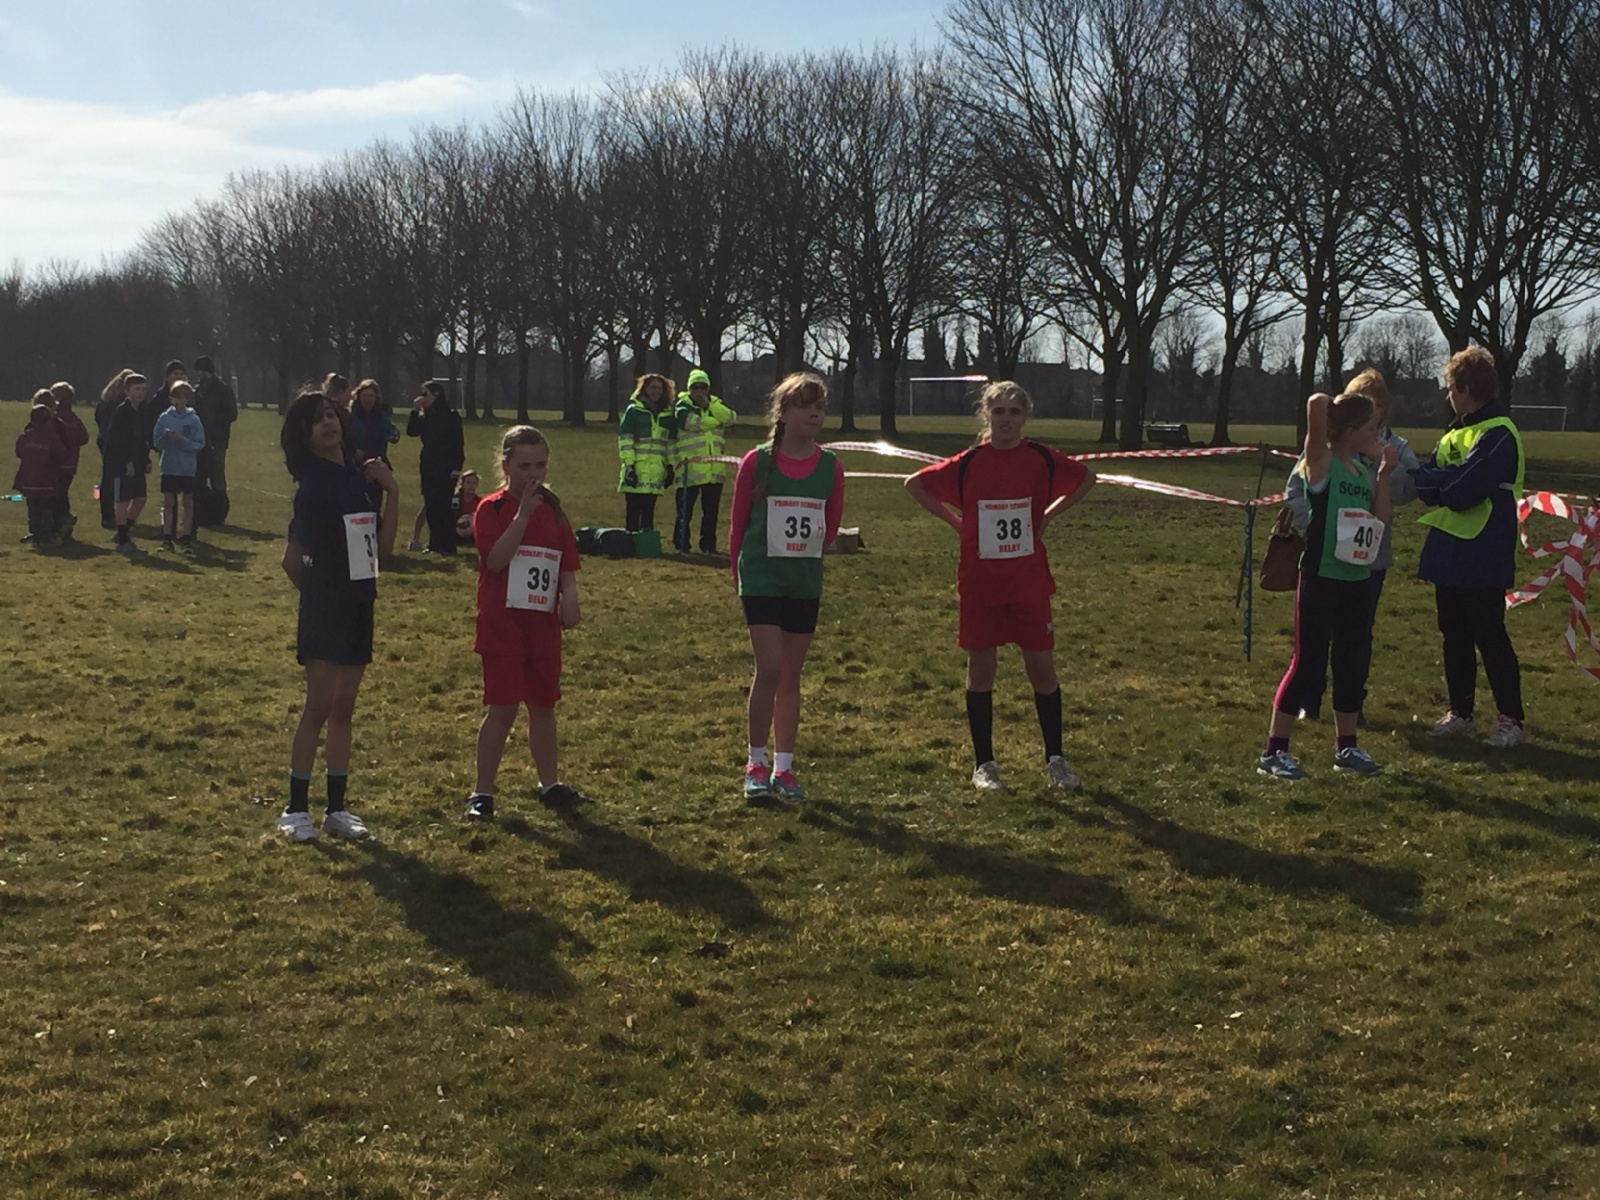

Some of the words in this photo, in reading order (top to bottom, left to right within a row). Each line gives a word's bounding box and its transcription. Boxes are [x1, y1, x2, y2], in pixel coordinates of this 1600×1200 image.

[785, 515, 812, 540] 35
[996, 517, 1022, 541] 38
[1353, 526, 1373, 549] 40
[787, 543, 807, 552] RELAY
[999, 544, 1020, 553] RELAY
[527, 566, 551, 592] 39
